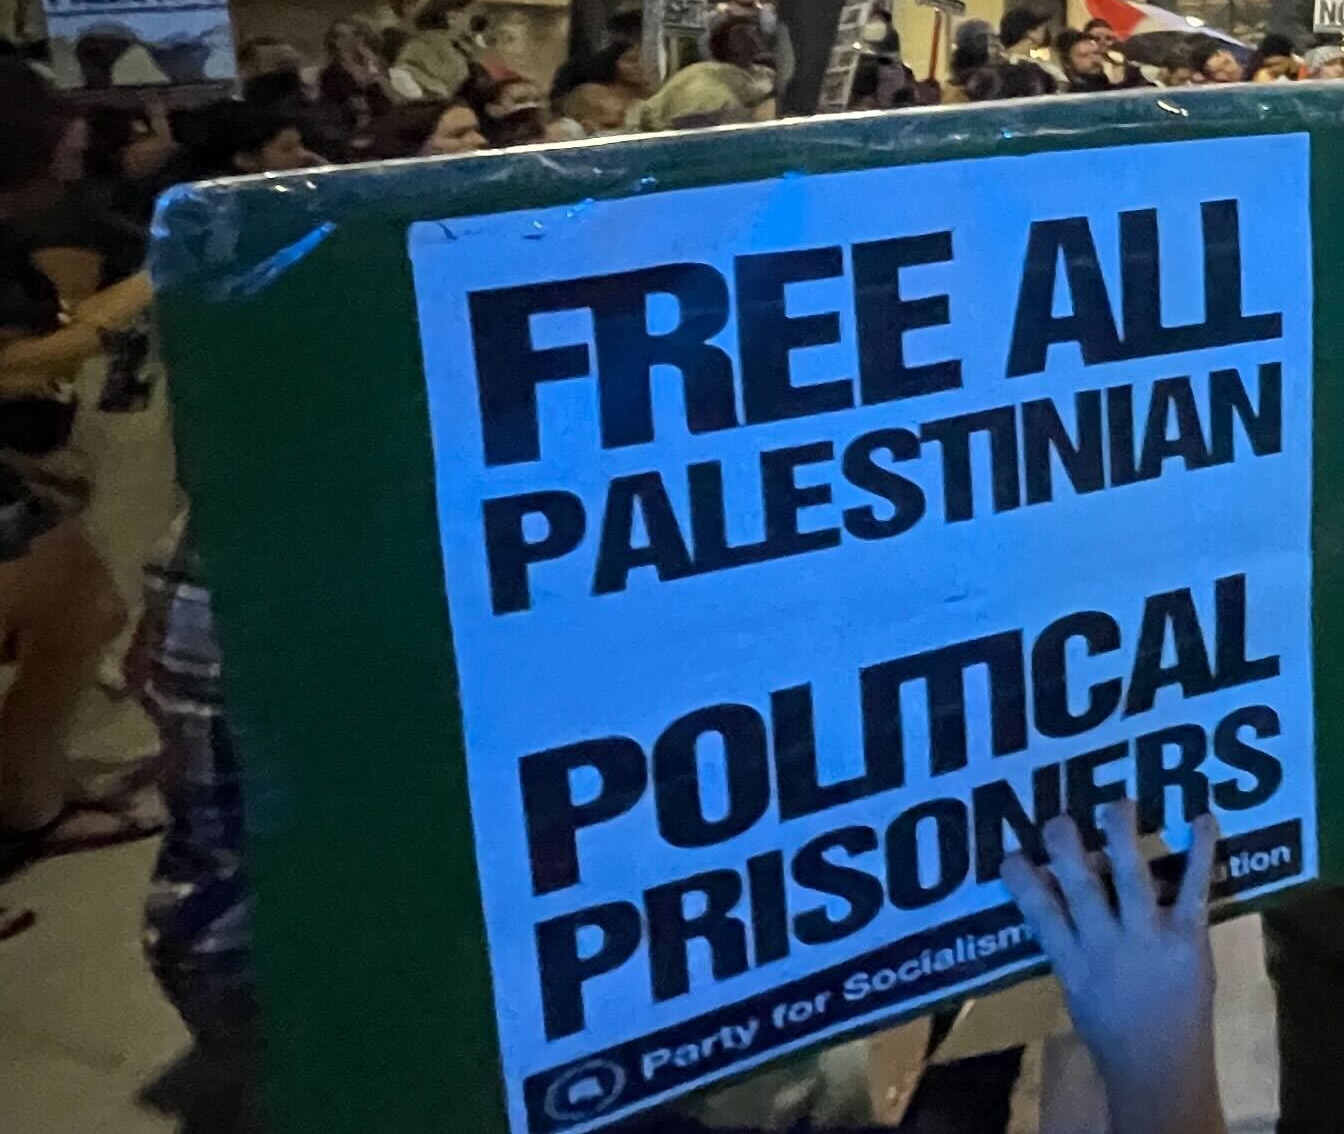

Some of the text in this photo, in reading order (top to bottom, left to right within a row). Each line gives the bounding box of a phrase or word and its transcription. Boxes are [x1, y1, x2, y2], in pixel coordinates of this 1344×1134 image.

[468, 198, 1283, 467] FREE ALL
[482, 361, 1283, 616] PALESTINIAN
[517, 573, 1281, 896] POLITICAL
[533, 704, 1283, 1042] PRISONERS
[642, 921, 1033, 1081] Party for Socialism
